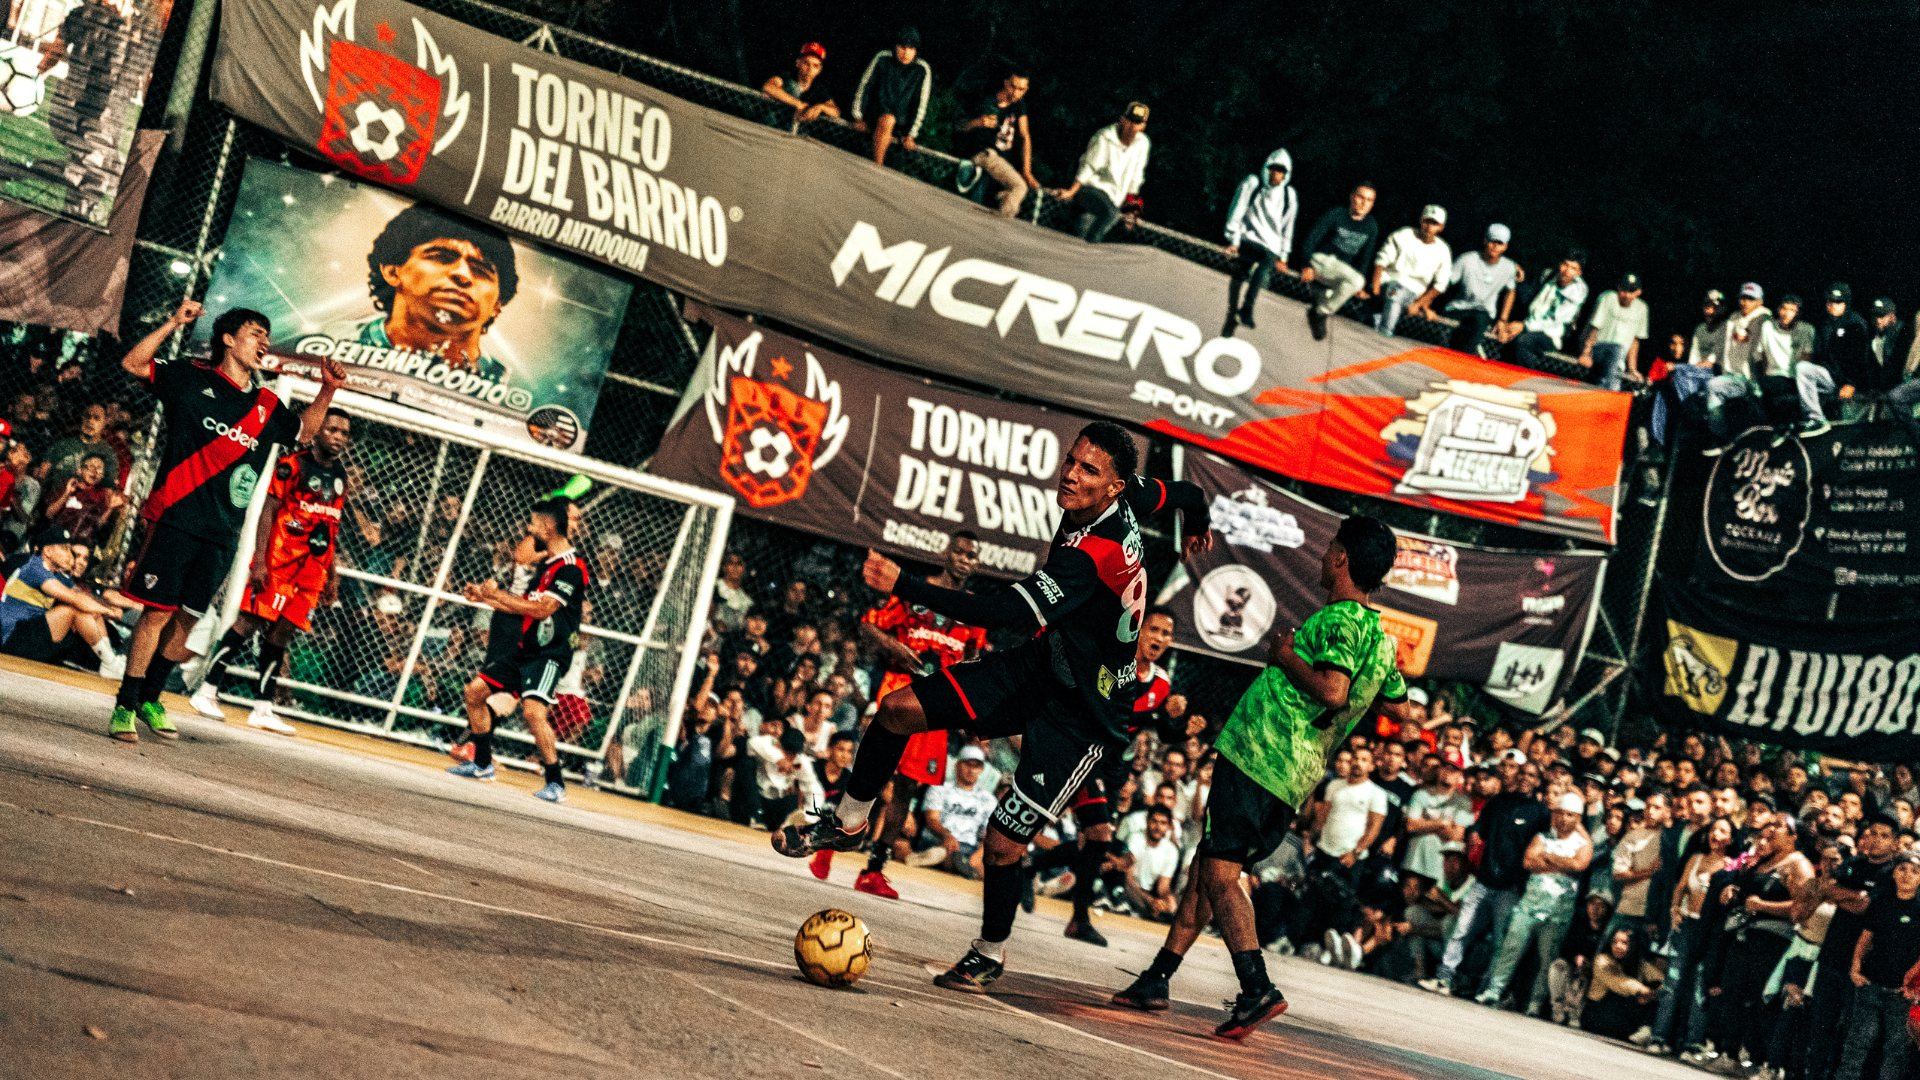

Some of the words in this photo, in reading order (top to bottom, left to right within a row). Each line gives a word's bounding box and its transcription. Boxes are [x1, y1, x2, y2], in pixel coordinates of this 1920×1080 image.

[511, 62, 672, 172] TORNEO
[489, 196, 560, 239] BARRIO
[557, 217, 650, 272] ANTIOQUIA
[501, 128, 573, 212] DEL
[579, 149, 728, 268] BARRIO
[830, 220, 1262, 397] MICRERO
[907, 397, 1060, 481] TORNEO
[1129, 379, 1236, 429] SPORT
[893, 453, 965, 524] DEL
[1036, 580, 1058, 605] CARD
[1771, 650, 1920, 738] FUTBO
